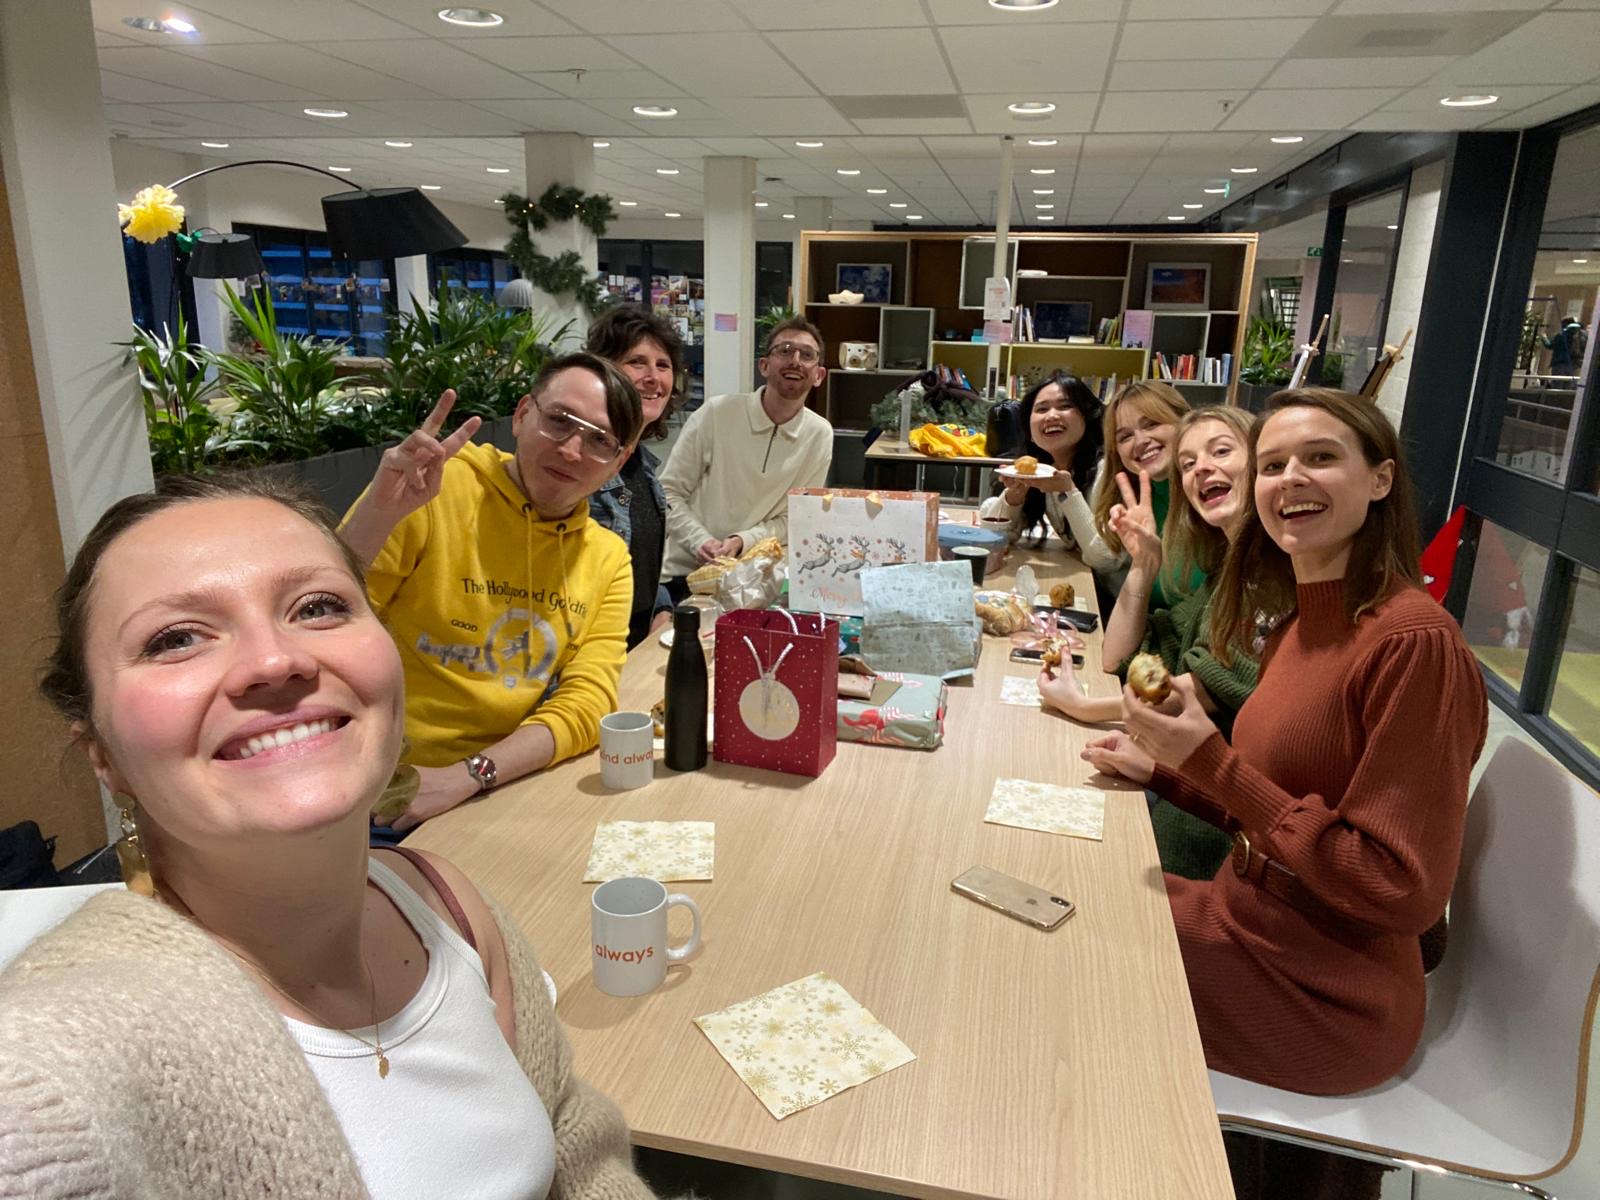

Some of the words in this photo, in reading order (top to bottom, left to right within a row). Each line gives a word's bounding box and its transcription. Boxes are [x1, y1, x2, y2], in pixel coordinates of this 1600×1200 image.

[461, 578, 485, 594] The
[451, 619, 478, 632] GOOD
[623, 750, 653, 765] alwa
[595, 944, 654, 965] always
